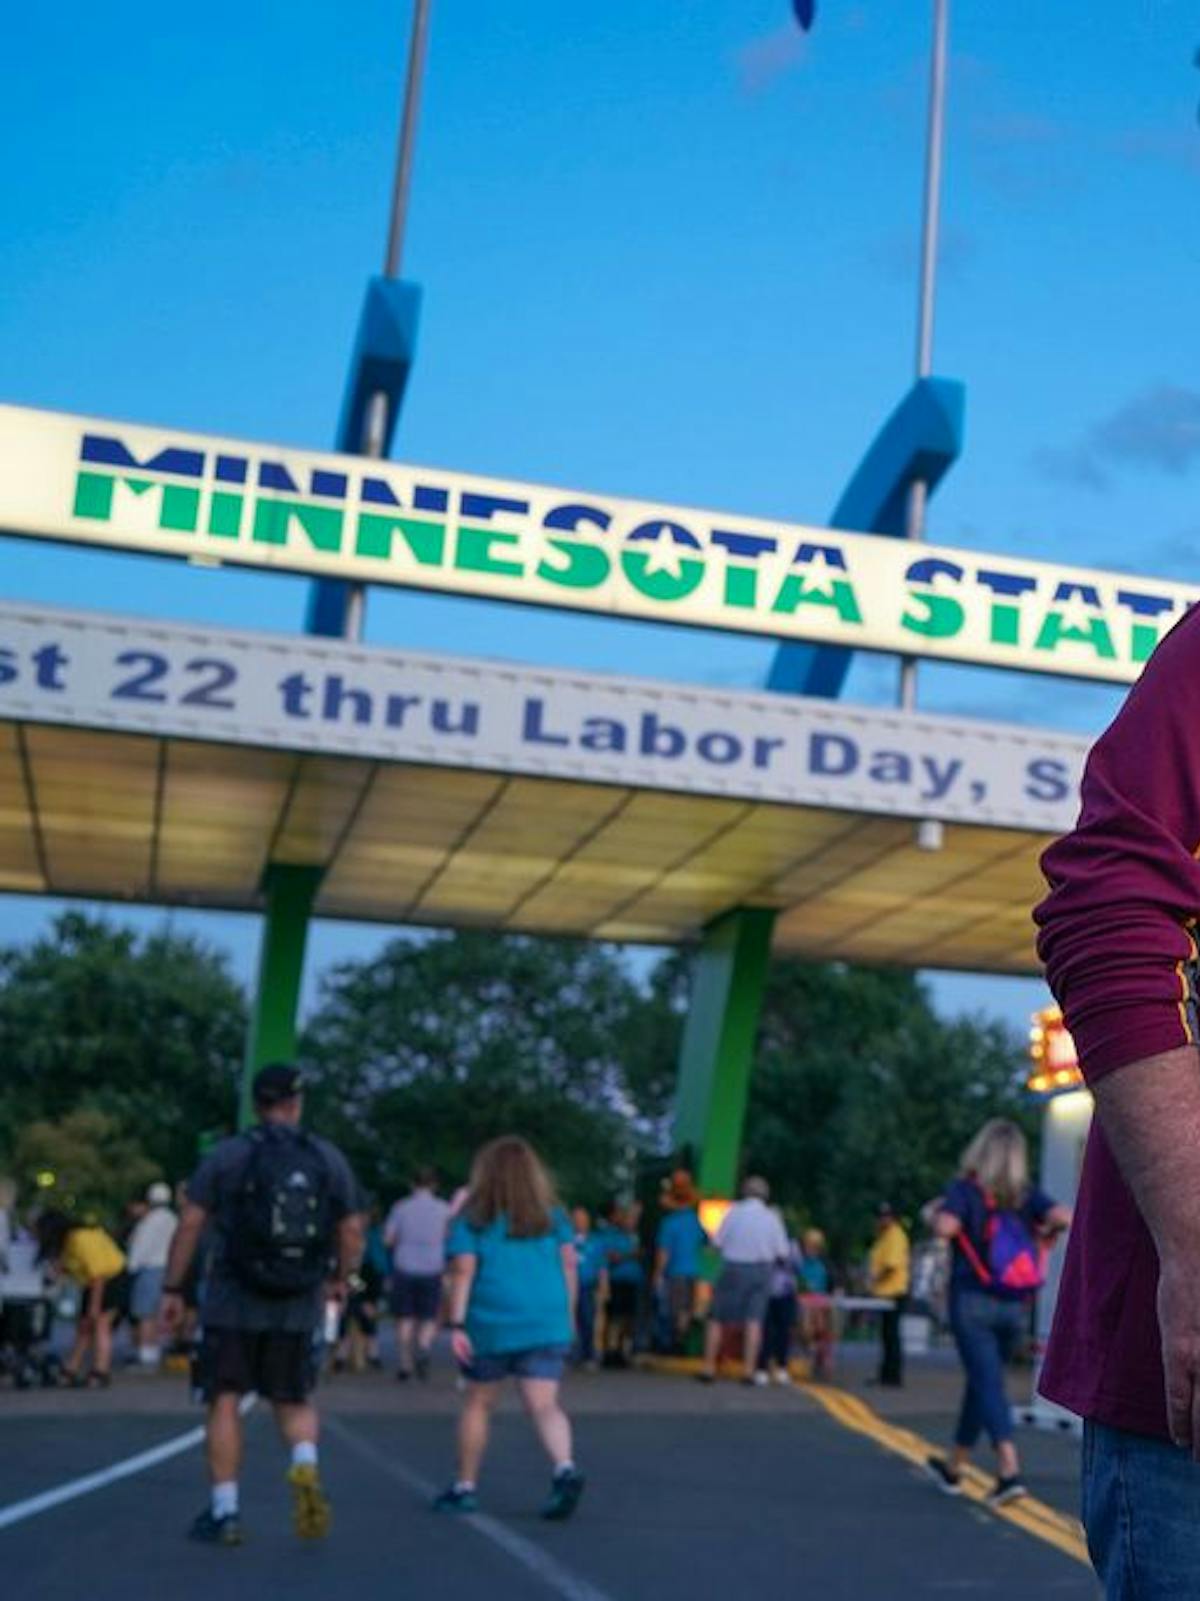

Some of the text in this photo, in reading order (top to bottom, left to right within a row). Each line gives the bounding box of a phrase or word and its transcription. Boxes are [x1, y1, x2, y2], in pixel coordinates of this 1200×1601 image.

[73, 433, 1193, 662] MINNESOTA STAT
[111, 650, 239, 710] 22
[278, 672, 481, 737] thru
[522, 697, 785, 770] Labor
[808, 730, 987, 805] Day,
